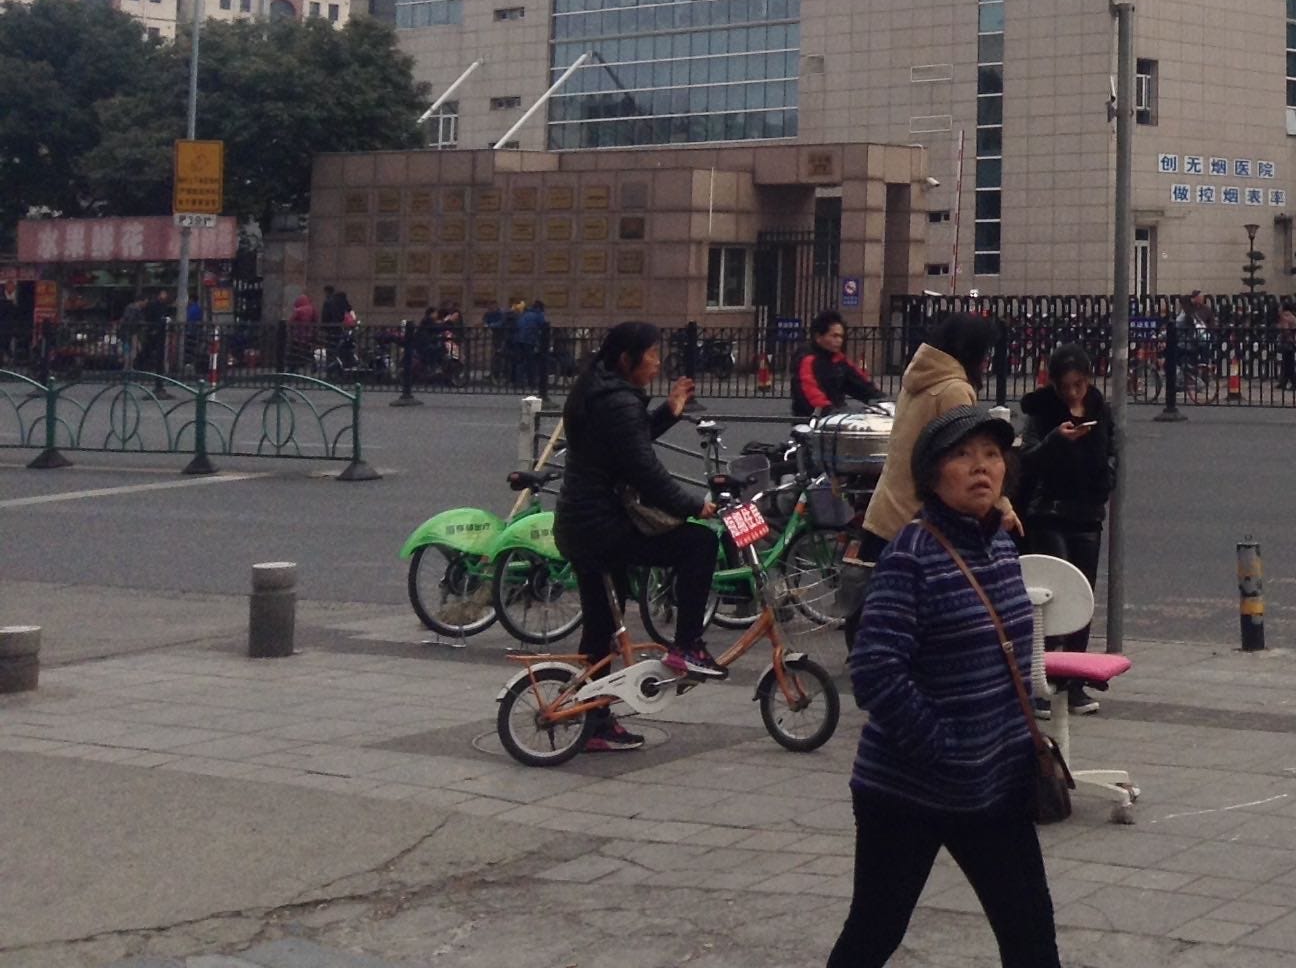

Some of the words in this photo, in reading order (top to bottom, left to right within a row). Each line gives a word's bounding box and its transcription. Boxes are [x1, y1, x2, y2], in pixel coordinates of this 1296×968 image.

[1160, 154, 1275, 178] 创无烟医院
[1172, 184, 1286, 206] 做控烟表率
